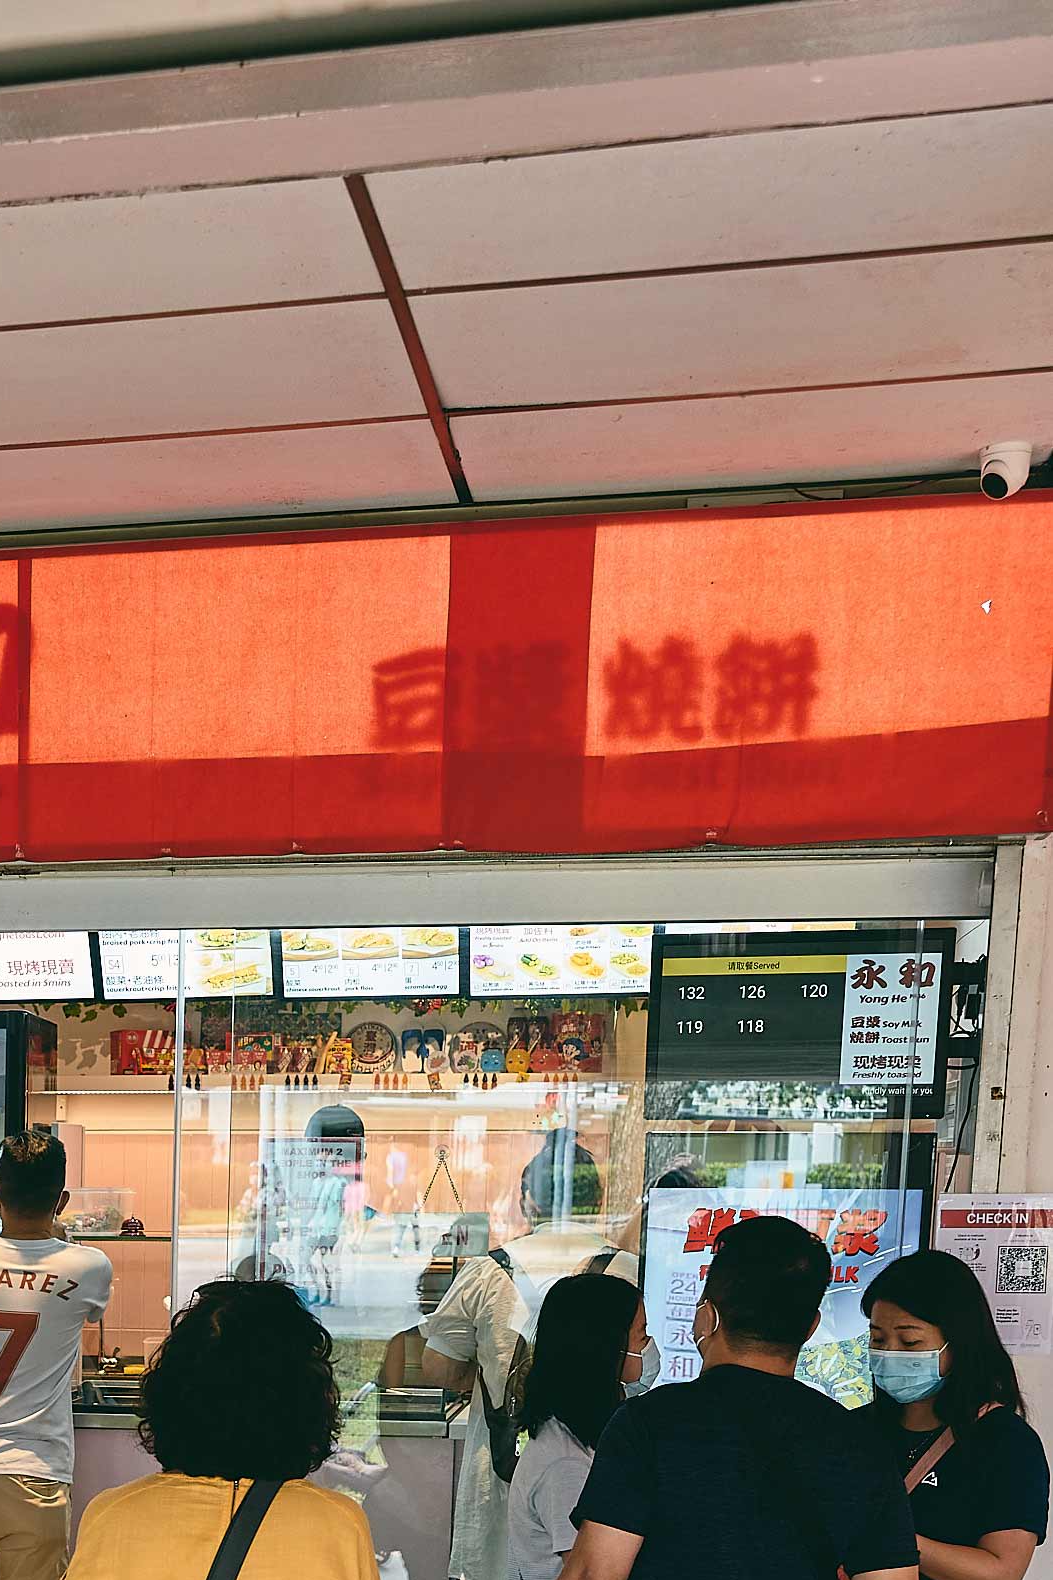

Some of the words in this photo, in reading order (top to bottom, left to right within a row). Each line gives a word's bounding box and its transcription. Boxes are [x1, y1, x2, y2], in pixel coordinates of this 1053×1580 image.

[8, 958, 75, 976] 現烤現賣
[850, 958, 936, 990] 永和
[32, 979, 41, 987] in
[678, 986, 705, 999] 132
[739, 985, 766, 999] 126
[800, 984, 828, 998] 120
[859, 994, 889, 1006] Yong
[891, 994, 908, 1003] He
[676, 1020, 704, 1034] 119
[737, 1019, 764, 1033] 118
[850, 1015, 881, 1029] 豆漿
[882, 1020, 900, 1029] Soy
[881, 1036, 908, 1044] Toast
[852, 1071, 886, 1080] Freshly
[888, 1087, 906, 1095] wait
[335, 1147, 344, 1156] 2
[966, 1212, 1012, 1224] CHECK
[1015, 1212, 1029, 1224] IN
[670, 1279, 697, 1295] 24
